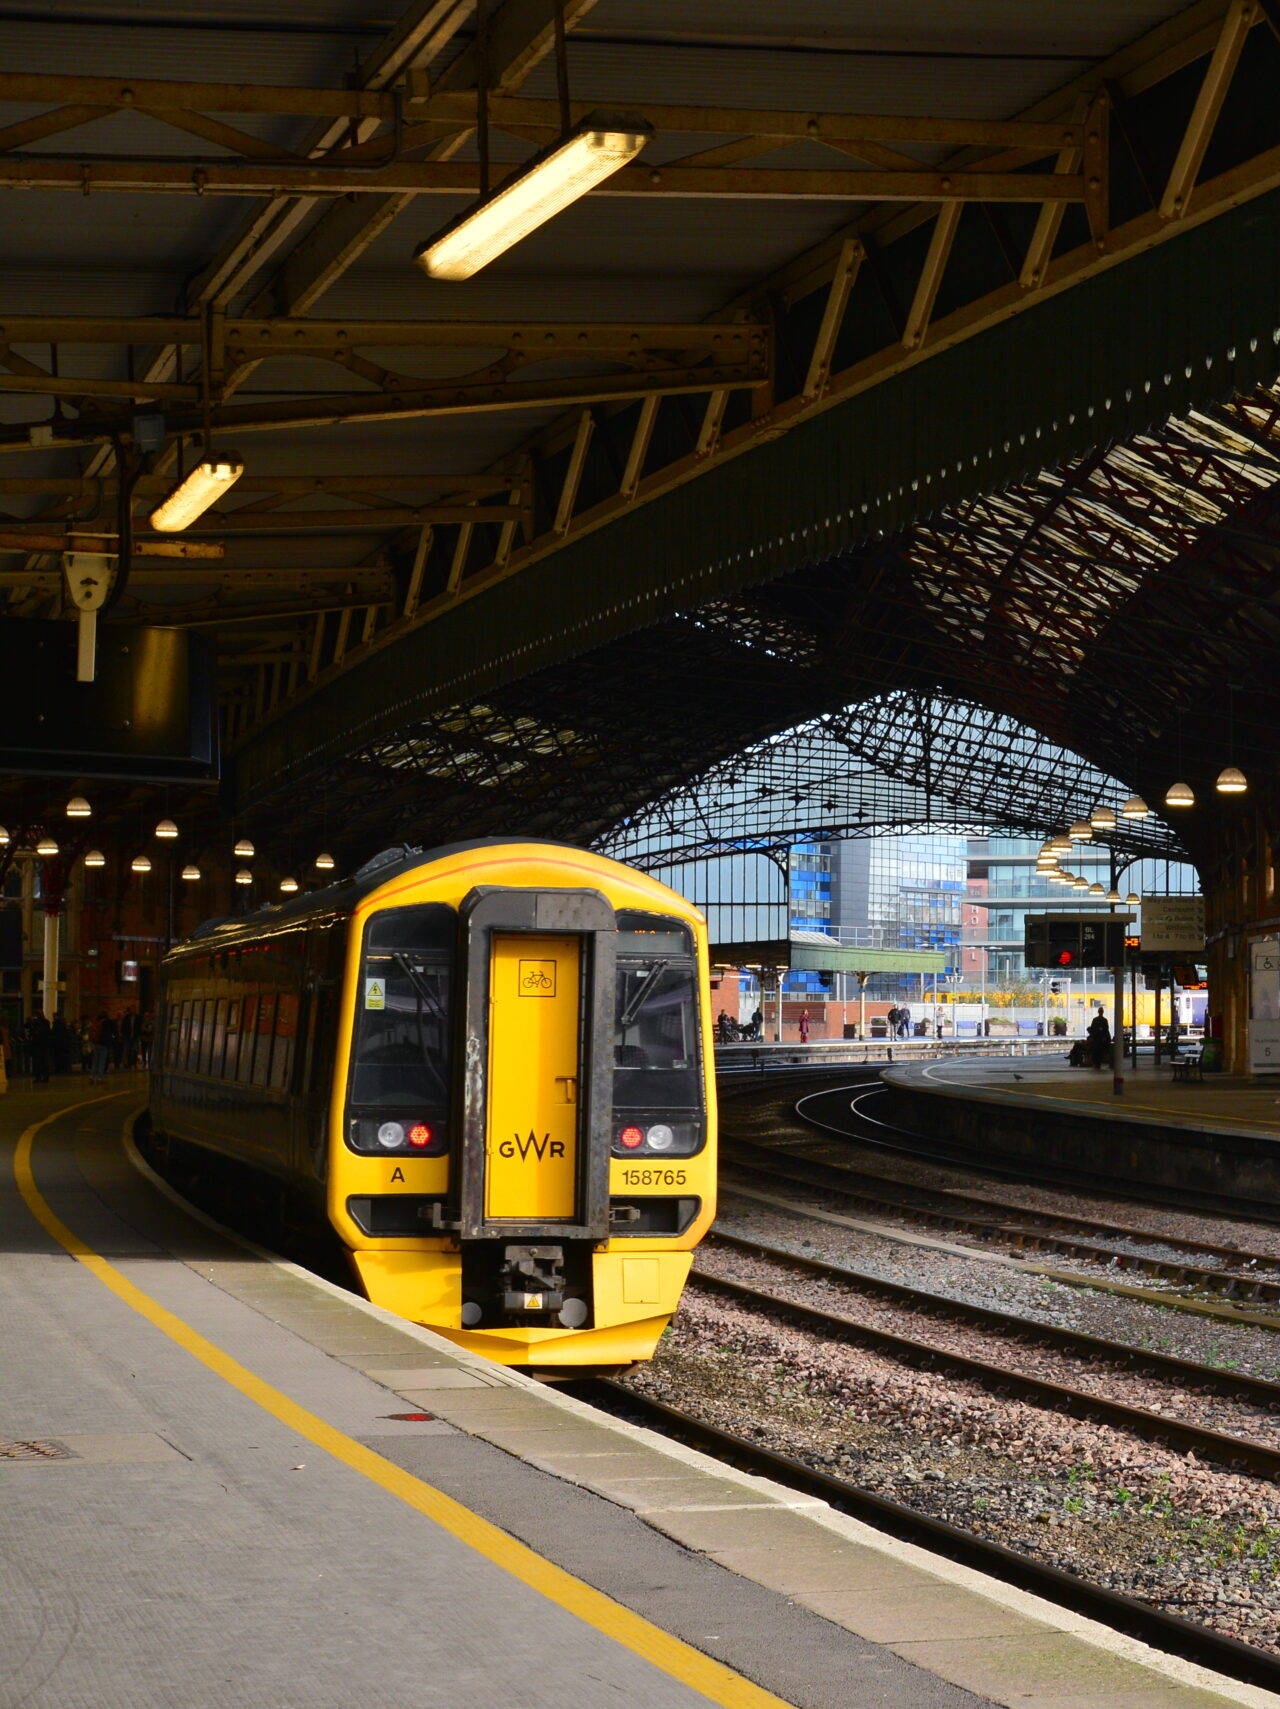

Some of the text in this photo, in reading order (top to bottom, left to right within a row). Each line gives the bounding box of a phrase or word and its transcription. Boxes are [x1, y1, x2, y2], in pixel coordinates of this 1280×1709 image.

[1264, 1047, 1271, 1057] 5
[499, 1129, 565, 1162] GWR
[390, 1167, 406, 1183] A
[621, 1168, 687, 1186] 158765
